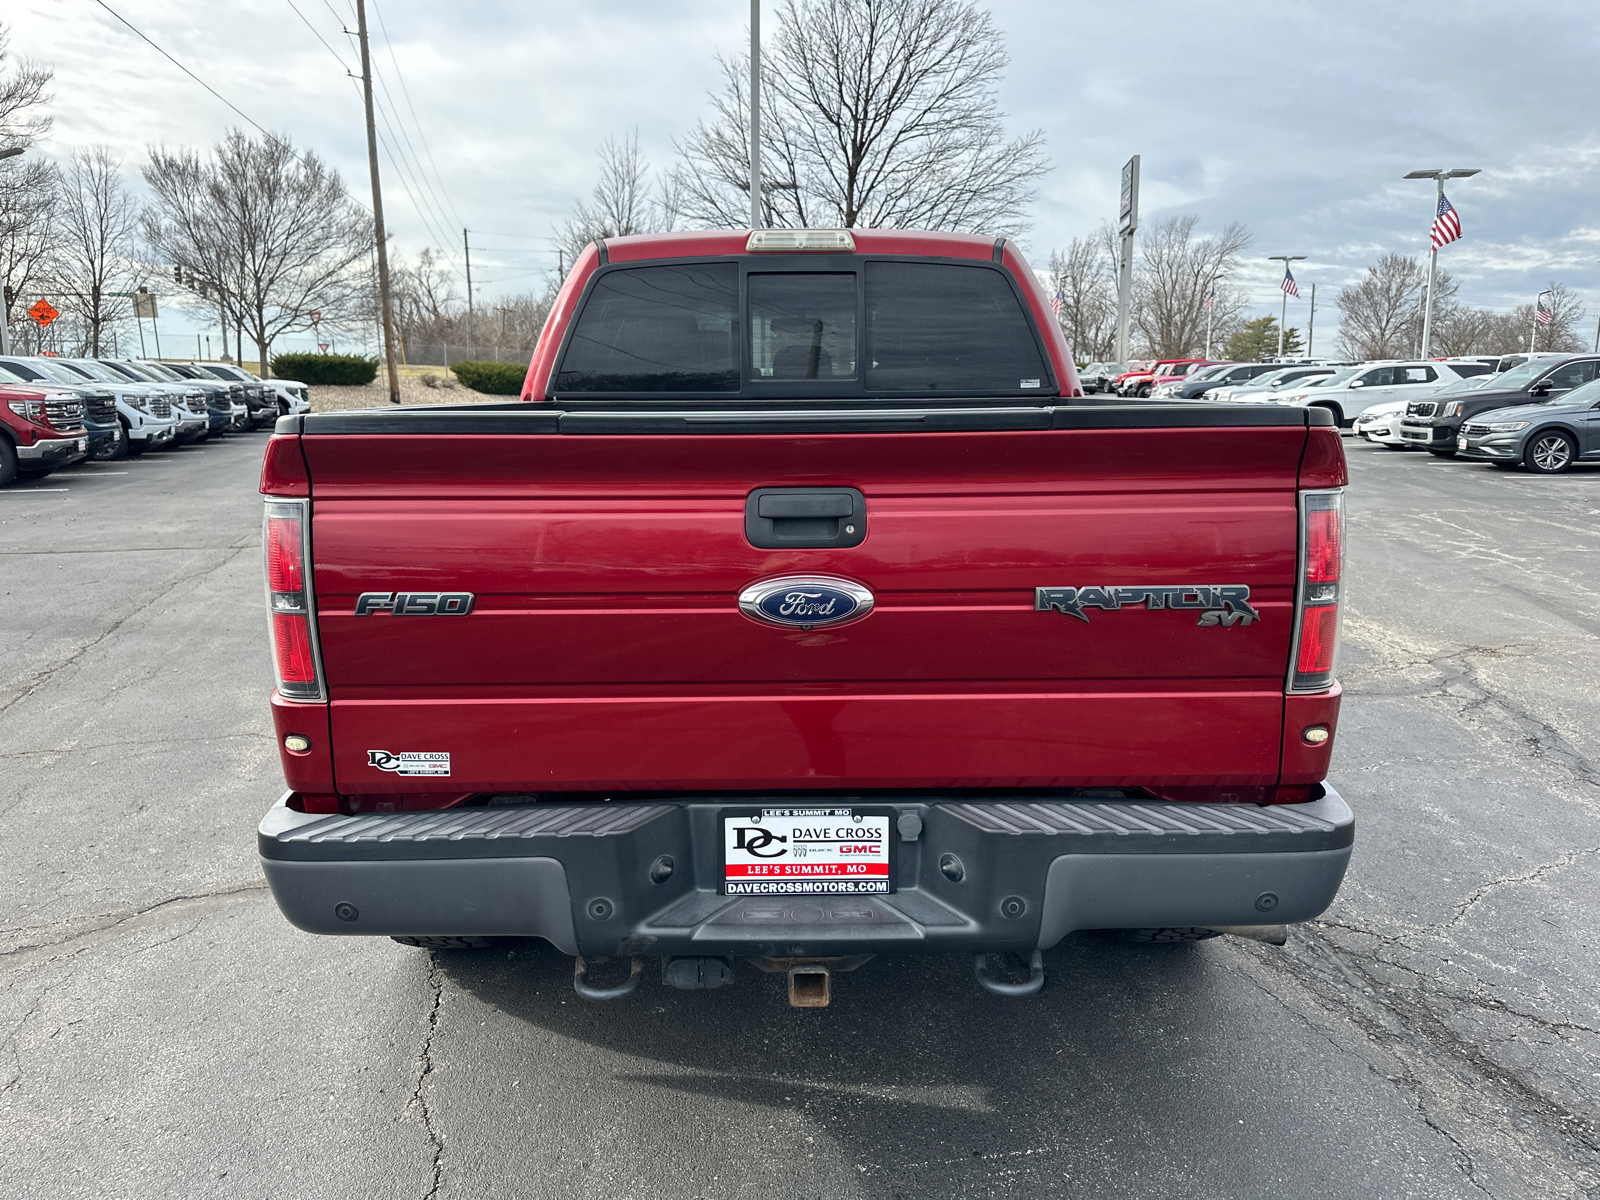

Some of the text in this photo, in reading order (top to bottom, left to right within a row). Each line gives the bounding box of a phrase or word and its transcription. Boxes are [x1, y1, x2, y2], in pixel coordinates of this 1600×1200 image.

[354, 592, 474, 616] F-150
[779, 592, 836, 616] Ford
[1035, 584, 1260, 624] RAPTOR
[793, 828, 882, 838] DAVE CROSS
[839, 845, 881, 853] GMC
[747, 865, 867, 875] LEE'S SUMMIT, MO
[728, 882, 887, 893] DAVECROSSMOTORS.COM
